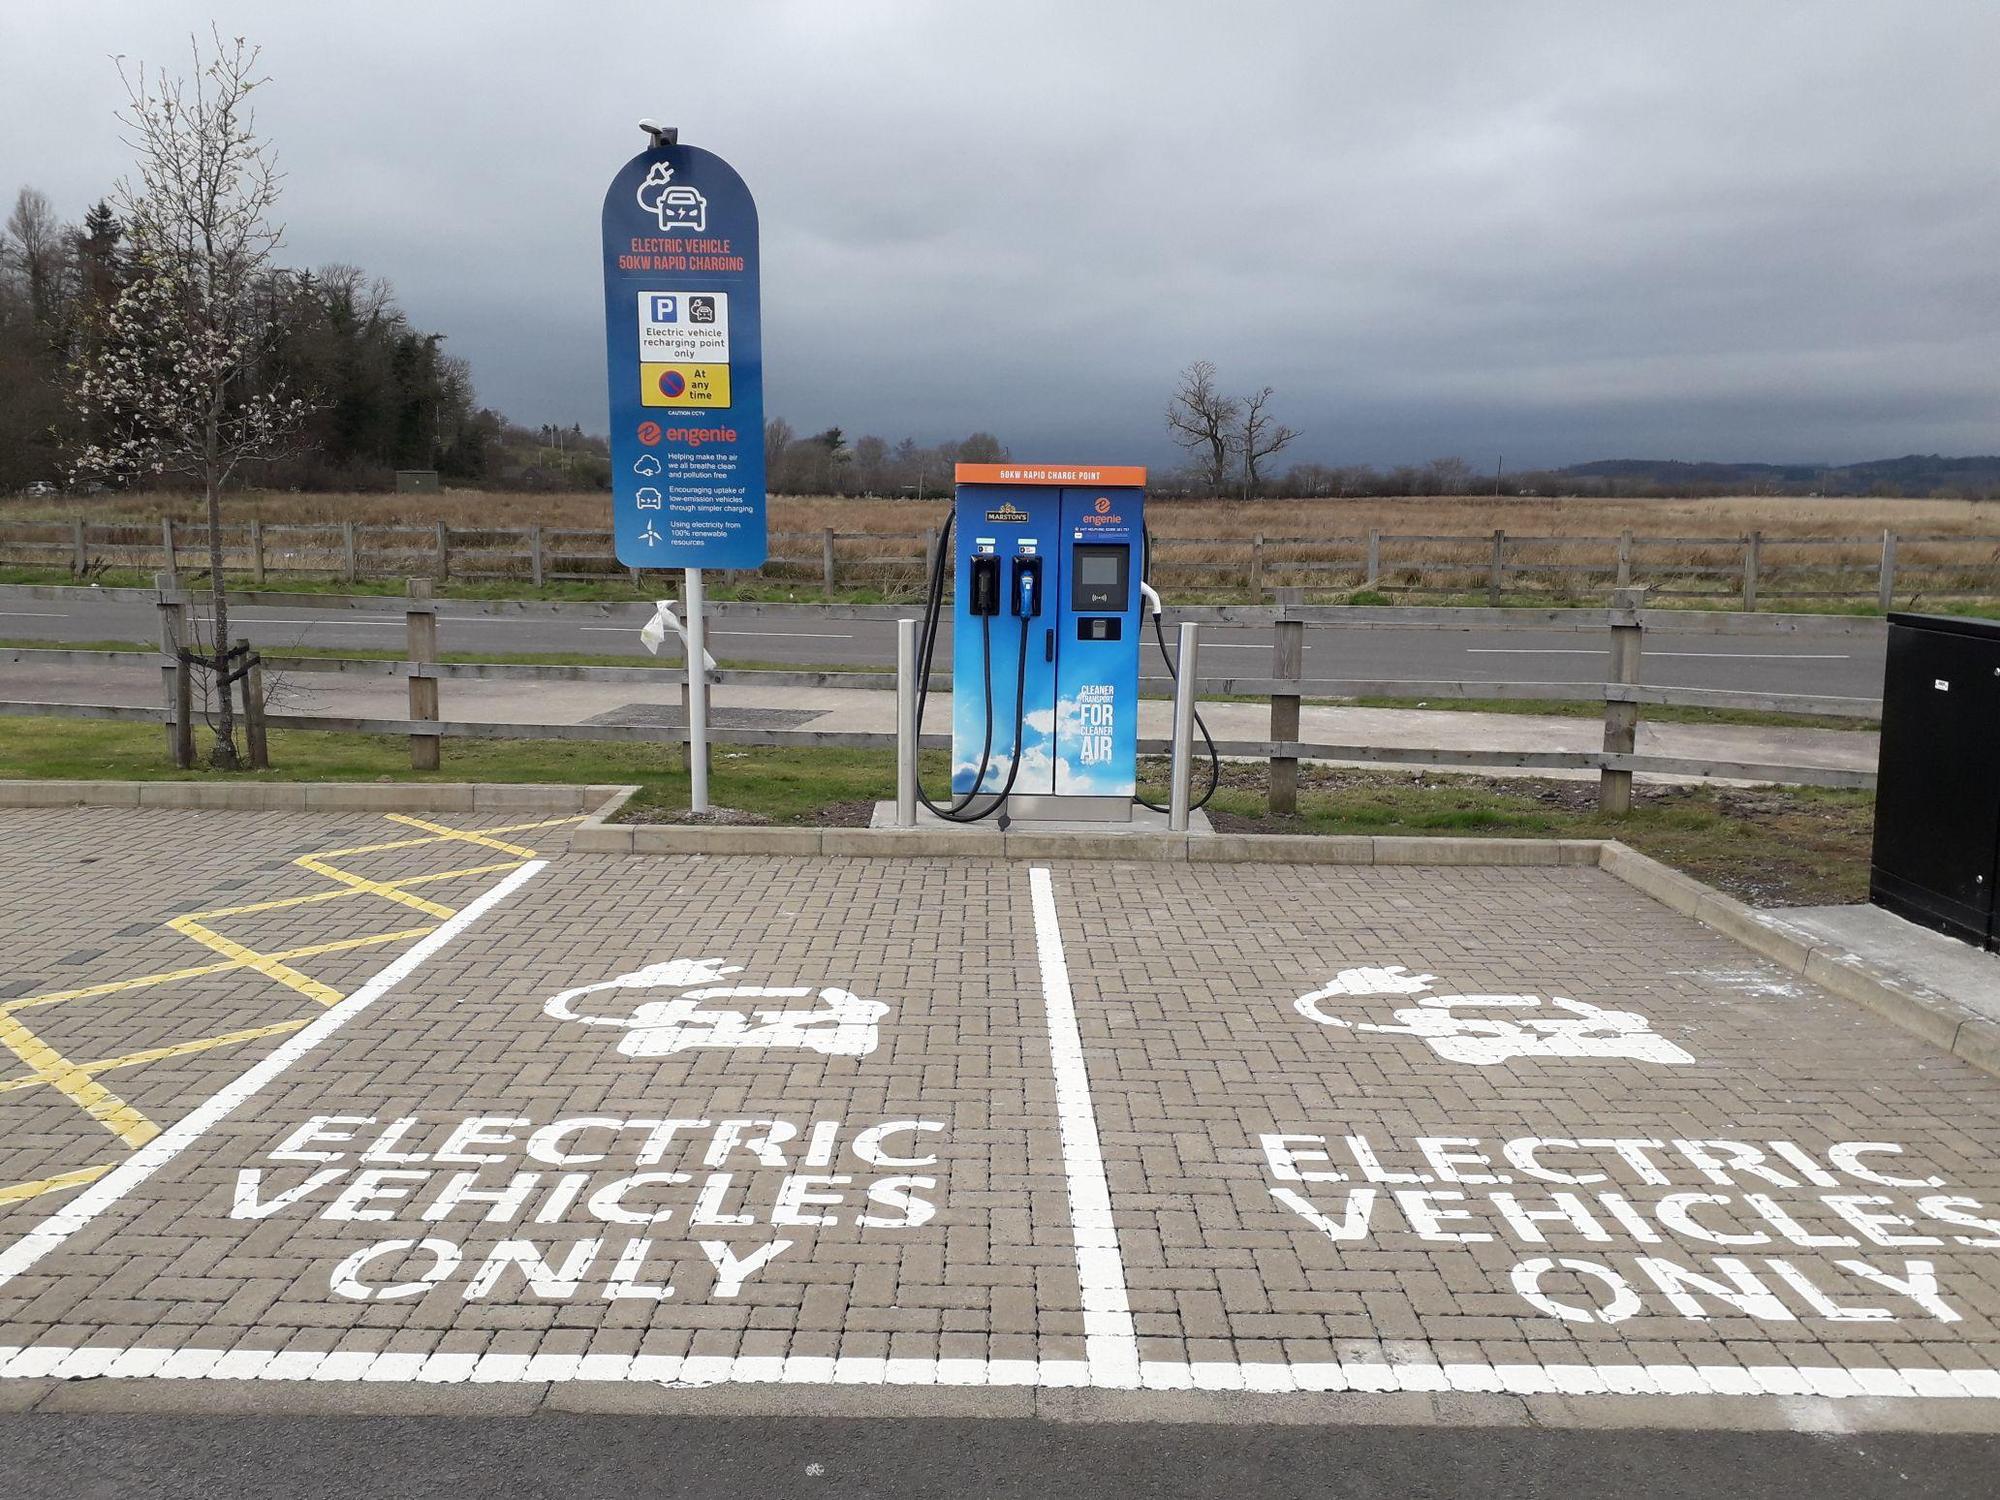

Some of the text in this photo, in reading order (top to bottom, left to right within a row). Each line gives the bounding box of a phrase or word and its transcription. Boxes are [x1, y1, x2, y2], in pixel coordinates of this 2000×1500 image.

[632, 238, 730, 254] ELECTRIC VEHICLE
[619, 256, 744, 271] 50KW RAPID CHARGING
[658, 299, 673, 320] P
[646, 328, 722, 337] Electric vehicle
[644, 339, 725, 348] recharging point
[674, 350, 694, 358] only
[694, 369, 706, 378] At
[692, 382, 709, 390] any
[690, 391, 712, 399] time
[666, 425, 736, 446] engenie
[668, 453, 694, 462] Helping
[684, 472, 712, 480] pollution
[1000, 471, 1100, 480] 50KW RAPID CHARGE POINT
[669, 486, 712, 495] Encouraging
[714, 487, 736, 495] uptake
[1083, 514, 1121, 525] engenie
[671, 521, 690, 529] Using
[692, 521, 723, 529] electricity
[1082, 685, 1114, 695] CLEANER
[1080, 704, 1113, 726] FOR
[1080, 727, 1113, 736] CLEANER
[1080, 736, 1112, 760] AIR
[267, 1116, 946, 1167] ELECTRIC
[1258, 1133, 1946, 1188] ELECTRIC
[229, 1168, 938, 1229] VEHICLES
[1269, 1187, 2000, 1249] VEHICLES
[330, 1238, 793, 1300] ONLY
[1509, 1256, 1963, 1323] ONLY
